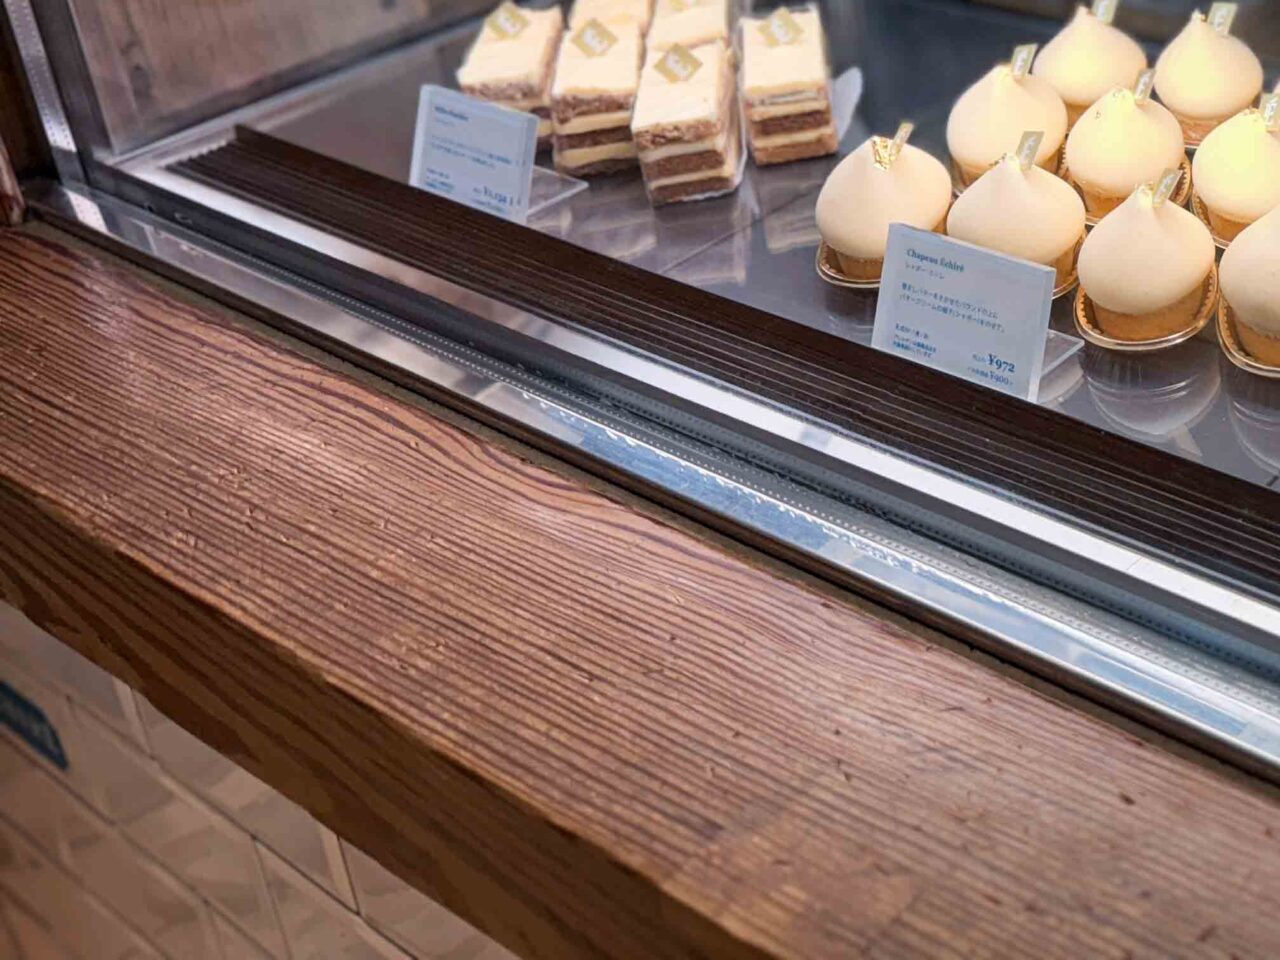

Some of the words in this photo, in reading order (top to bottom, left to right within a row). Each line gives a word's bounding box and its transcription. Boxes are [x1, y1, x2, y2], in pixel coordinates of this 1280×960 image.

[906, 248, 938, 266] Chapeau
[940, 256, 965, 273] Échiré
[987, 353, 1016, 373] ¥972
